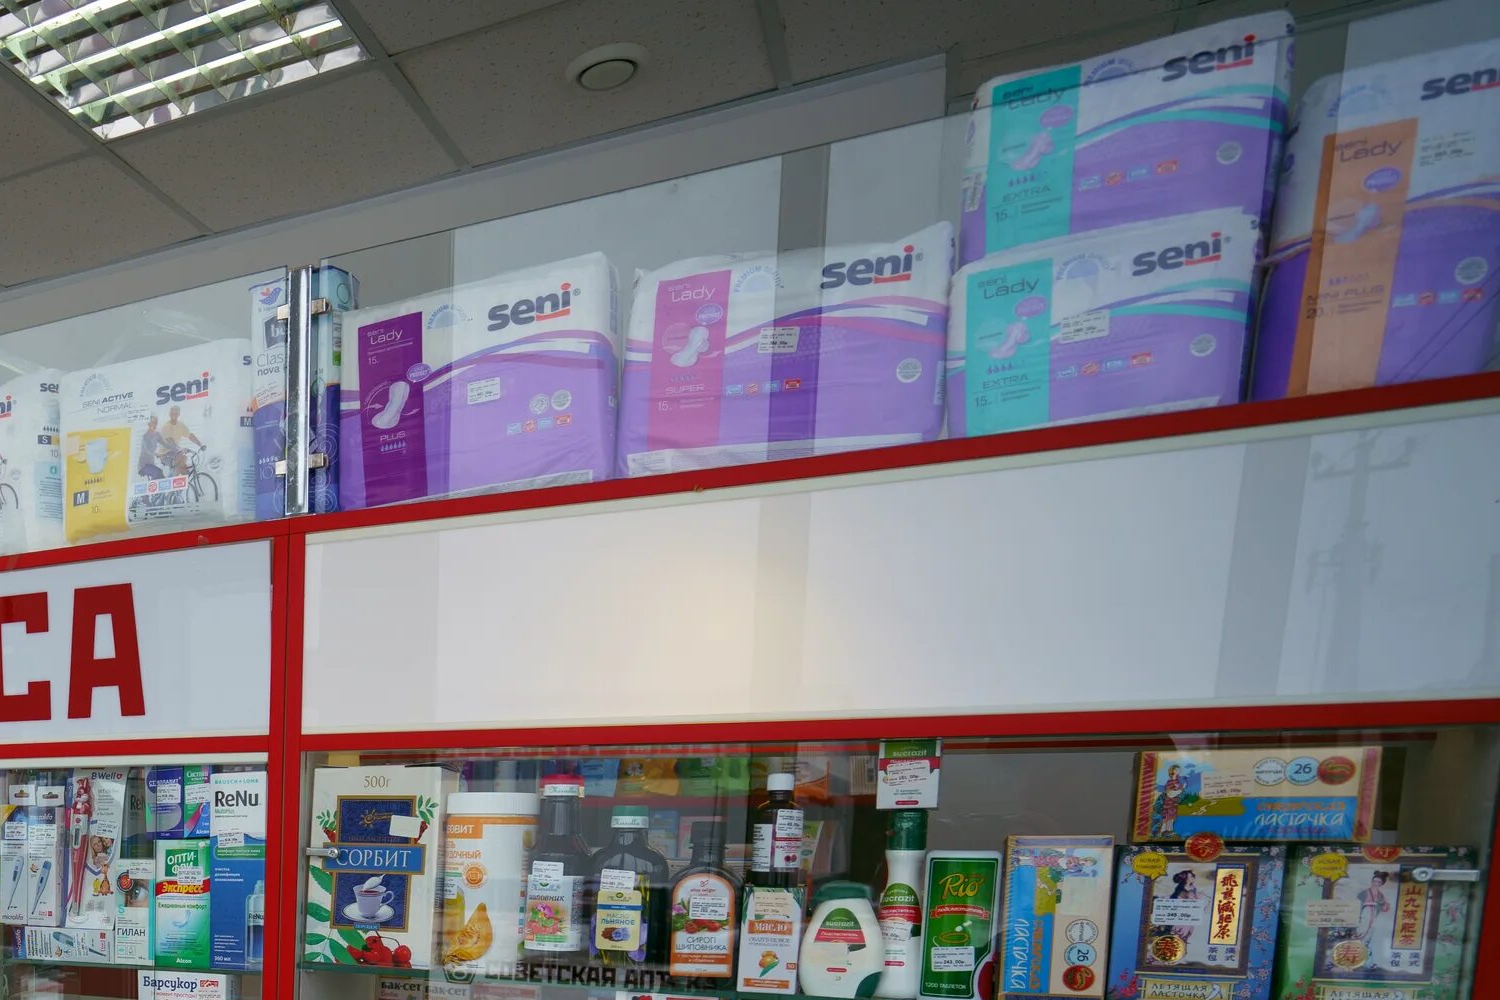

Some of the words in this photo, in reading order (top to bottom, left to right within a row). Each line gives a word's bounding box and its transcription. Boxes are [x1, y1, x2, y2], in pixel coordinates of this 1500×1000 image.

[1163, 34, 1255, 83] seni
[1338, 136, 1403, 163] Lady
[1132, 232, 1222, 278] seni
[820, 245, 915, 290] seni
[670, 285, 716, 303] Lady
[983, 277, 1040, 300] Lady
[487, 282, 574, 332] seni
[369, 327, 404, 347] Lady
[257, 366, 279, 376] nova
[156, 372, 211, 406] seni
[665, 382, 705, 395] SUPER
[364, 776, 390, 788] 500г
[215, 791, 259, 806] ReNu
[336, 849, 411, 867] СОРБИТ
[942, 875, 986, 898] Rio
[601, 918, 635, 927] ЛЬНЯНОЕ
[826, 920, 854, 928] sucrazit
[117, 927, 146, 937] ГИЛАН
[686, 936, 716, 944] СИРОП
[675, 942, 727, 952] ШИПОВНИКА
[143, 976, 197, 991] Барсукор
[1152, 983, 1207, 991] ЛЕТЯЩАЯ
